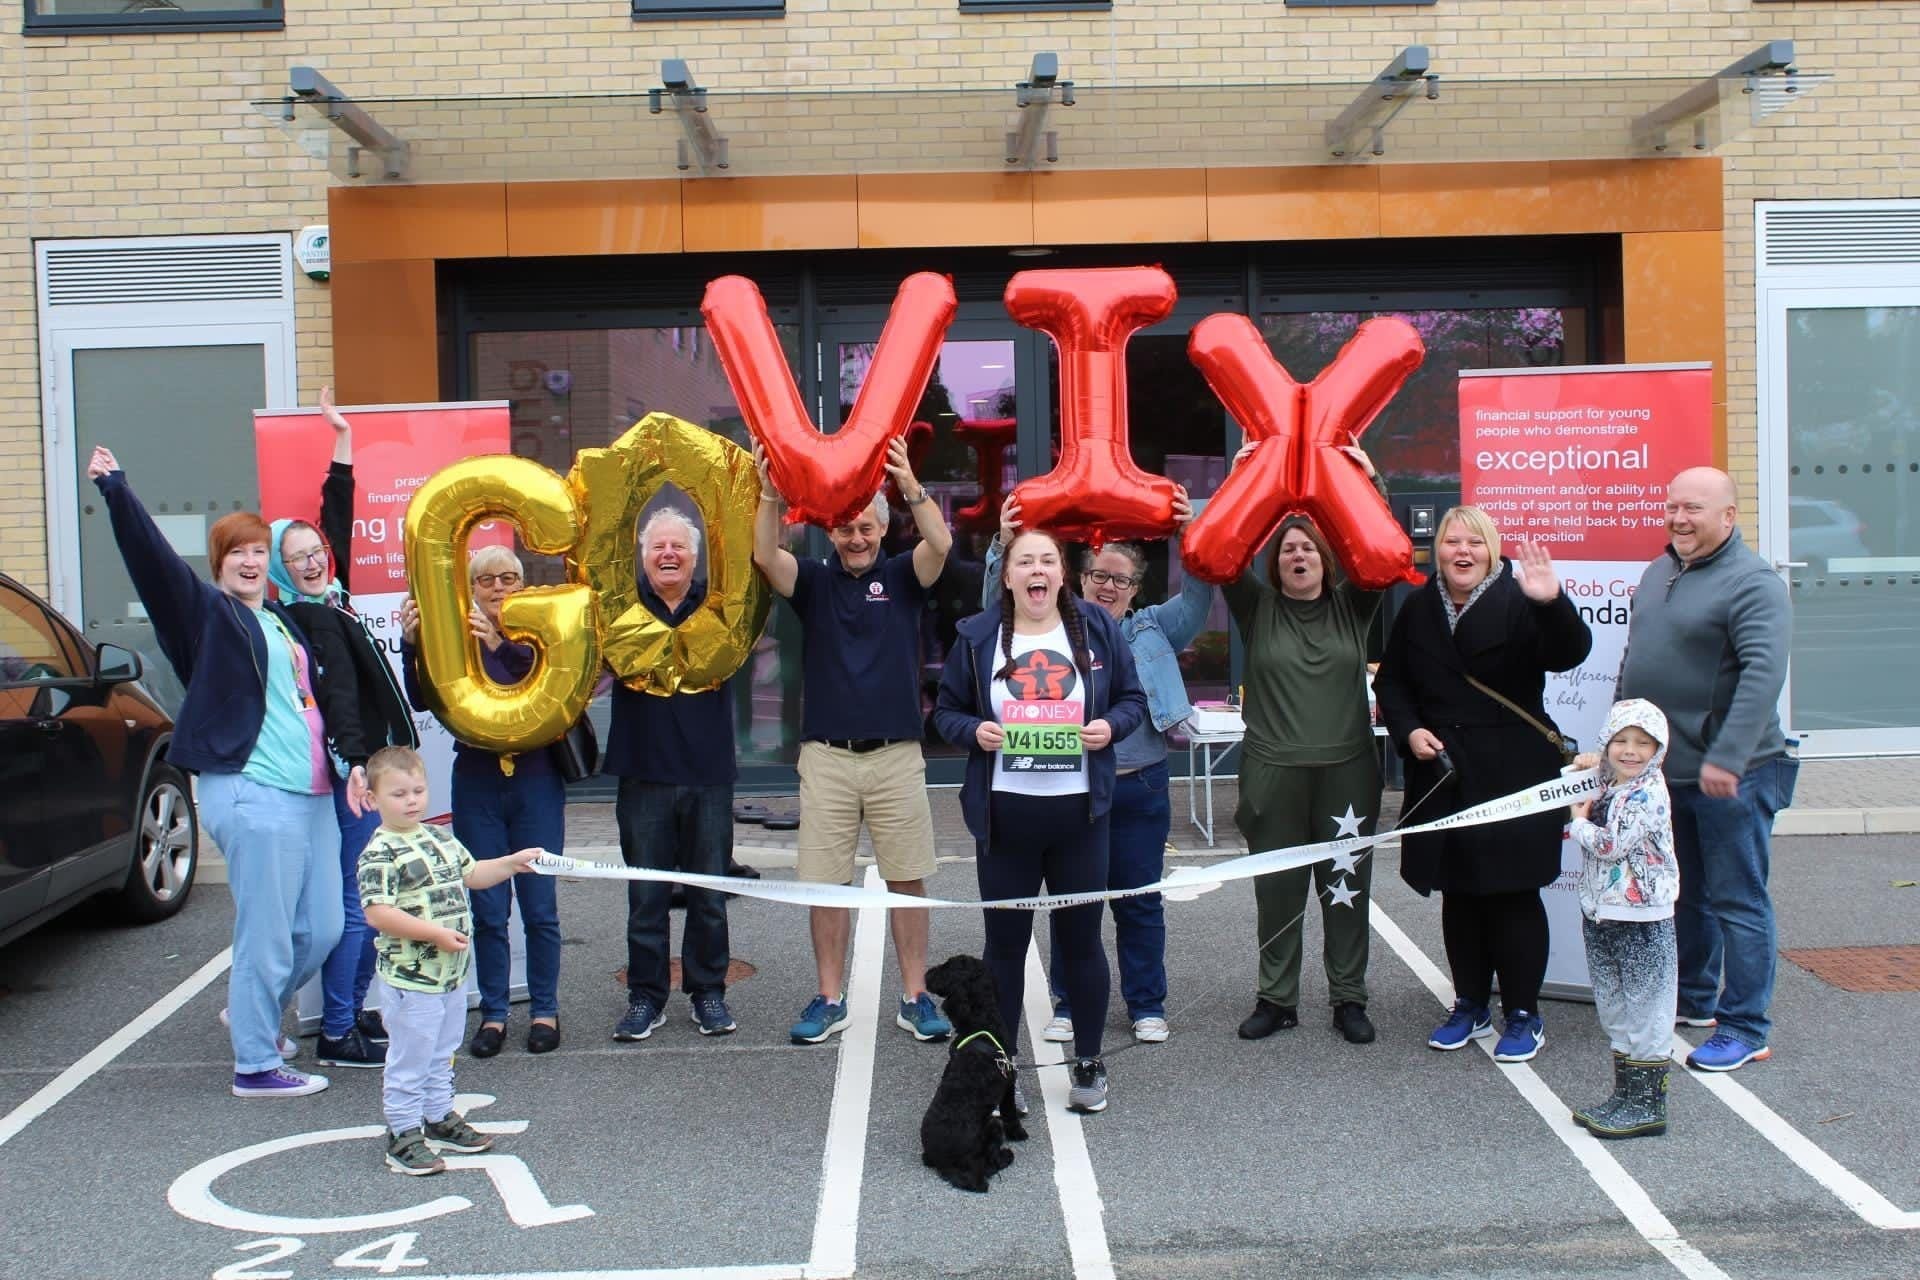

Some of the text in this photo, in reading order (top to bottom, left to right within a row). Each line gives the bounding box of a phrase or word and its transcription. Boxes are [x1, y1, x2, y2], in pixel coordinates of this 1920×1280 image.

[1476, 407, 1650, 423] financial support for young
[702, 264, 1427, 590] VIX
[1476, 424, 1638, 438] people who demonstrate
[1476, 443, 1648, 475] exceptional
[395, 476, 428, 489] pract
[1476, 483, 1555, 496] commitment
[1559, 482, 1601, 496] and/or
[1605, 482, 1646, 496] ability
[1650, 482, 1662, 495] in
[367, 492, 412, 504] financi
[1476, 499, 1666, 513] worlds of sport or the perform
[1503, 515, 1524, 526] but
[1528, 517, 1550, 526] are
[1554, 514, 1582, 526] held
[1586, 514, 1617, 527] back
[1621, 515, 1638, 529] by
[1642, 514, 1665, 527] the
[1498, 530, 1584, 544] ncial position
[356, 552, 405, 565] with life
[1565, 578, 1604, 597] Rob
[1006, 730, 1078, 749] V41555
[1047, 762, 1075, 770] balance
[212, 1232, 429, 1280] 24
